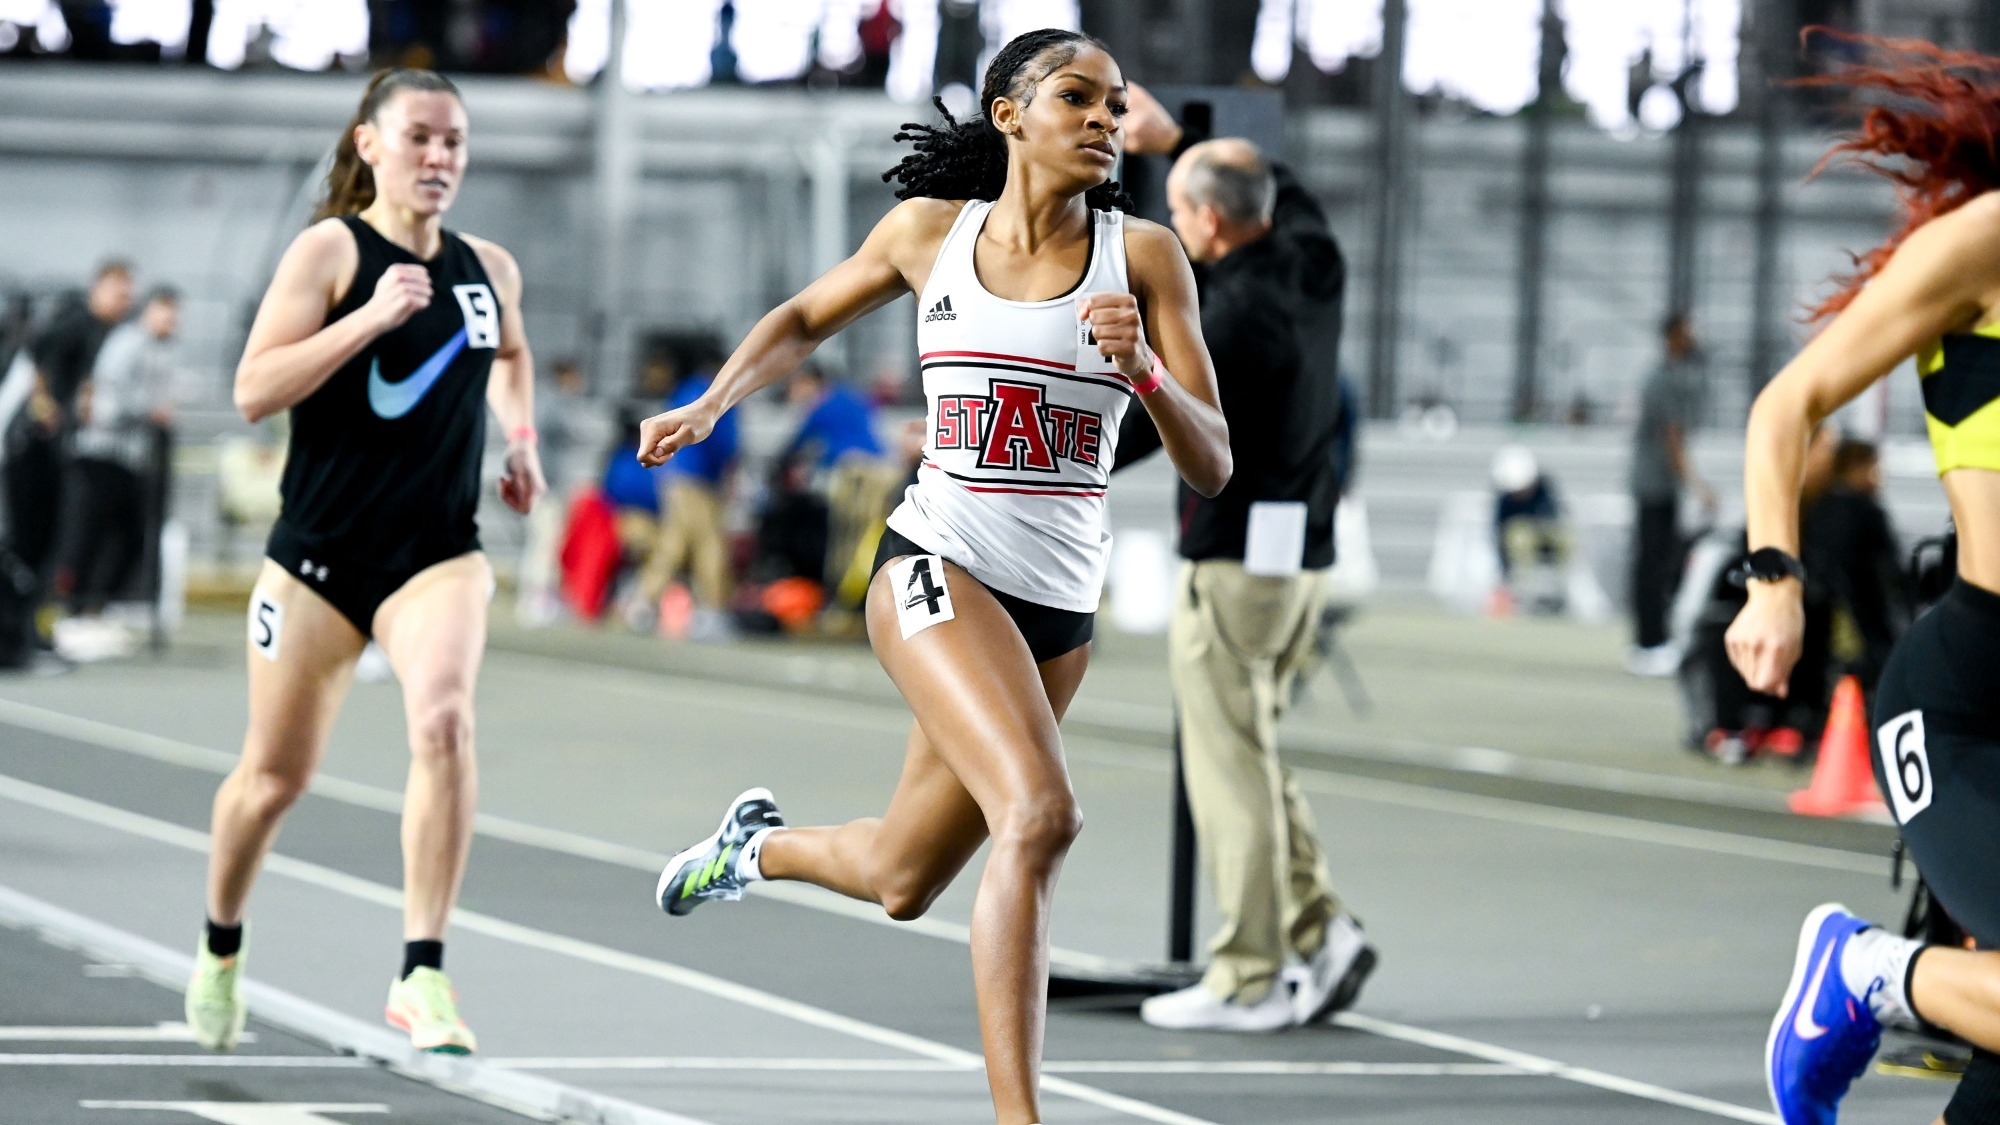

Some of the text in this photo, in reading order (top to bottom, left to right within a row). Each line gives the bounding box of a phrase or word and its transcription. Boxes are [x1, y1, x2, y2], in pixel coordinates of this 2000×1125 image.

[925, 311, 957, 323] adidas
[936, 378, 1102, 473] STATE
[904, 558, 945, 616] 4
[257, 601, 275, 648] 5
[1895, 720, 1924, 803] 6
